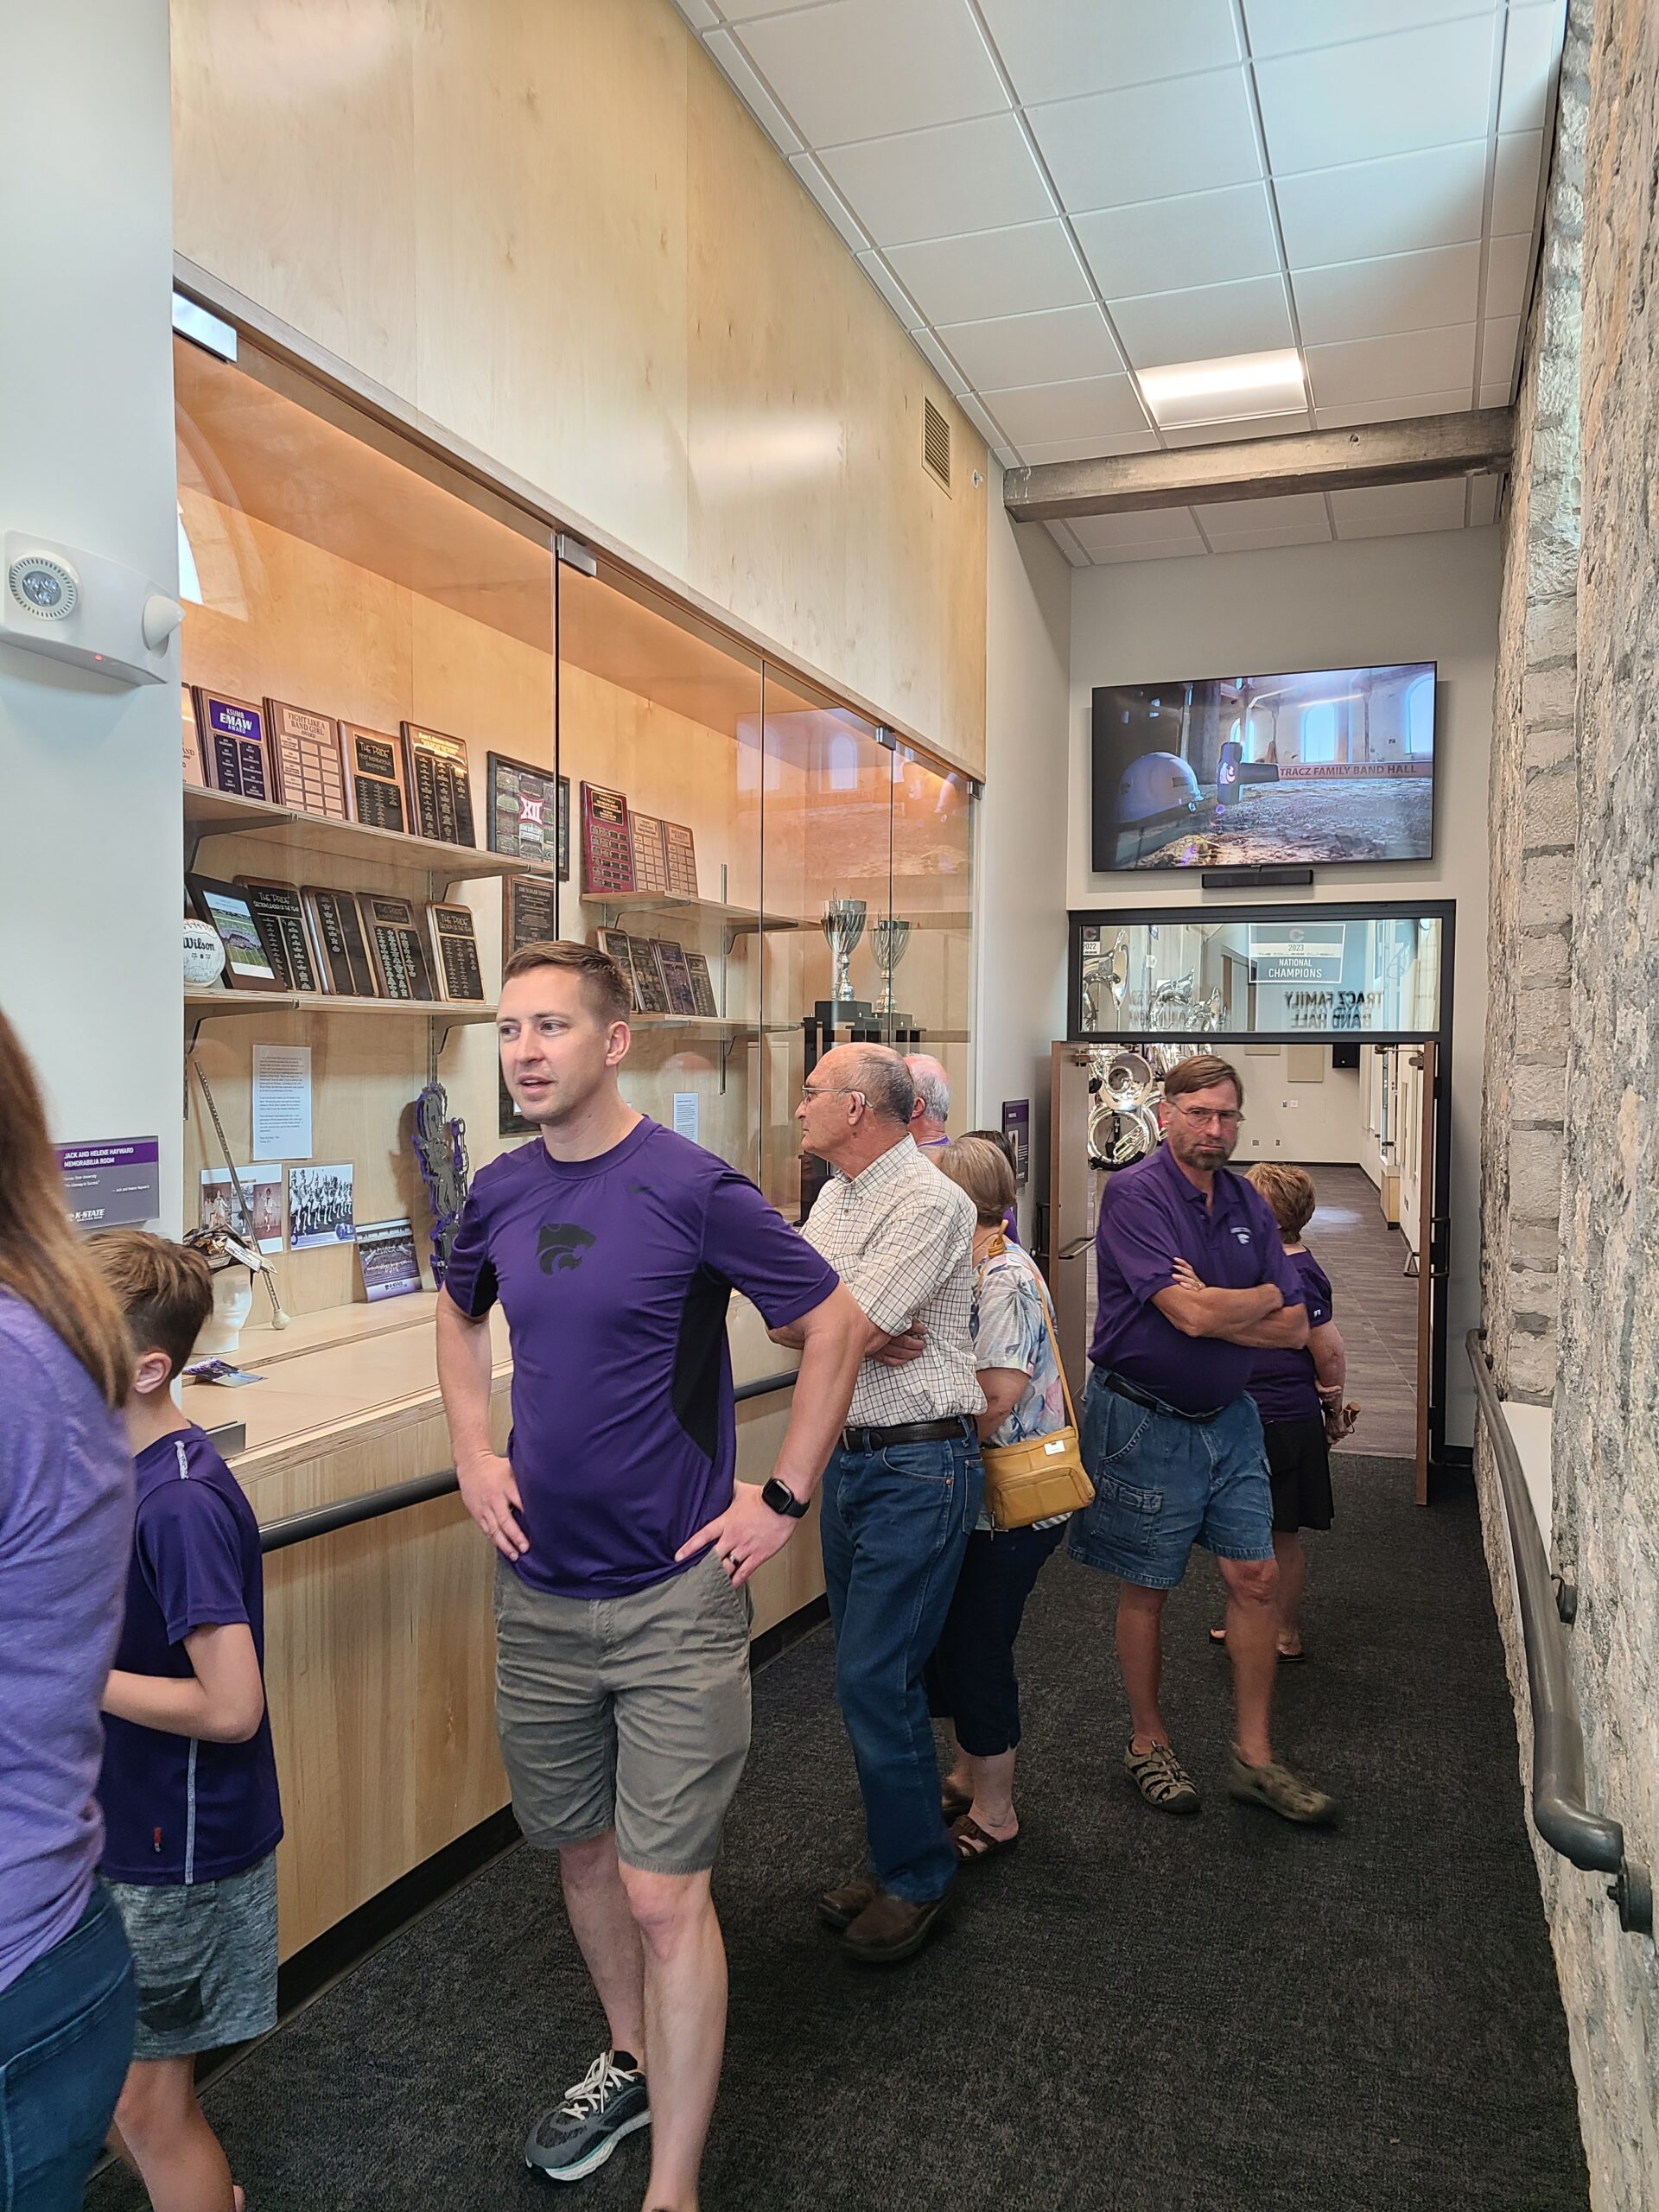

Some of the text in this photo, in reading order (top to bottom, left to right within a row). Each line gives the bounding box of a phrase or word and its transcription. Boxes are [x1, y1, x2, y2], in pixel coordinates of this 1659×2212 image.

[226, 708, 245, 719] KSUMB
[219, 713, 252, 730] EMAW
[288, 712, 306, 724] FIGHT
[308, 719, 321, 728] LIKE
[228, 725, 246, 734] AWARD
[291, 720, 324, 735] BAND GIRL
[1280, 765, 1417, 776] TRACZ FAMILY BAND HALL
[258, 892, 270, 902] THE
[441, 913, 451, 924] THE
[183, 938, 215, 951] Wilson
[1279, 958, 1312, 967] NATIONAL
[1268, 968, 1322, 978] CHAMPIONS
[64, 1158, 99, 1167] MEMORABILIA
[75, 1208, 105, 1219] K-STATE
